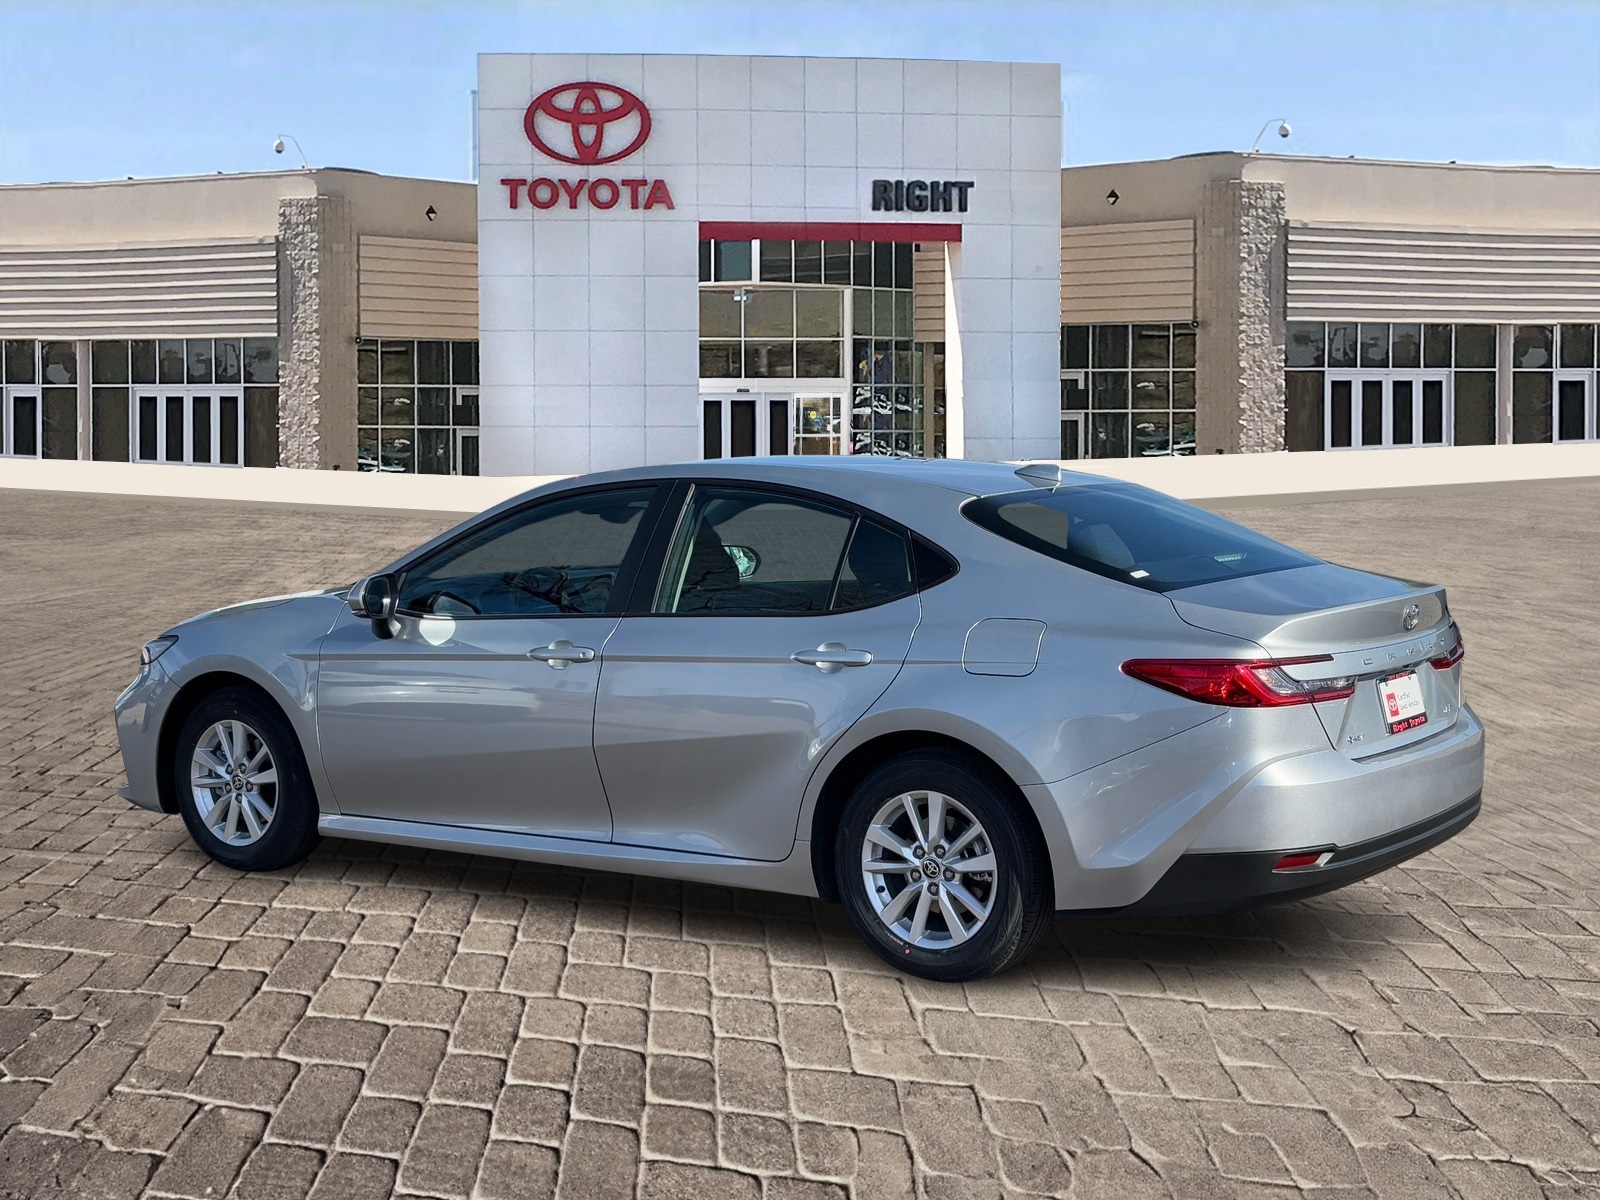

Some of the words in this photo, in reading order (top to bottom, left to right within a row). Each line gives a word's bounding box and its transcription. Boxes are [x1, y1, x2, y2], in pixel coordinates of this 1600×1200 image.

[500, 178, 675, 210] TOYOTA
[872, 179, 975, 213] RIGHT
[1393, 722, 1408, 732] Right
[1409, 716, 1425, 727] Toyota
